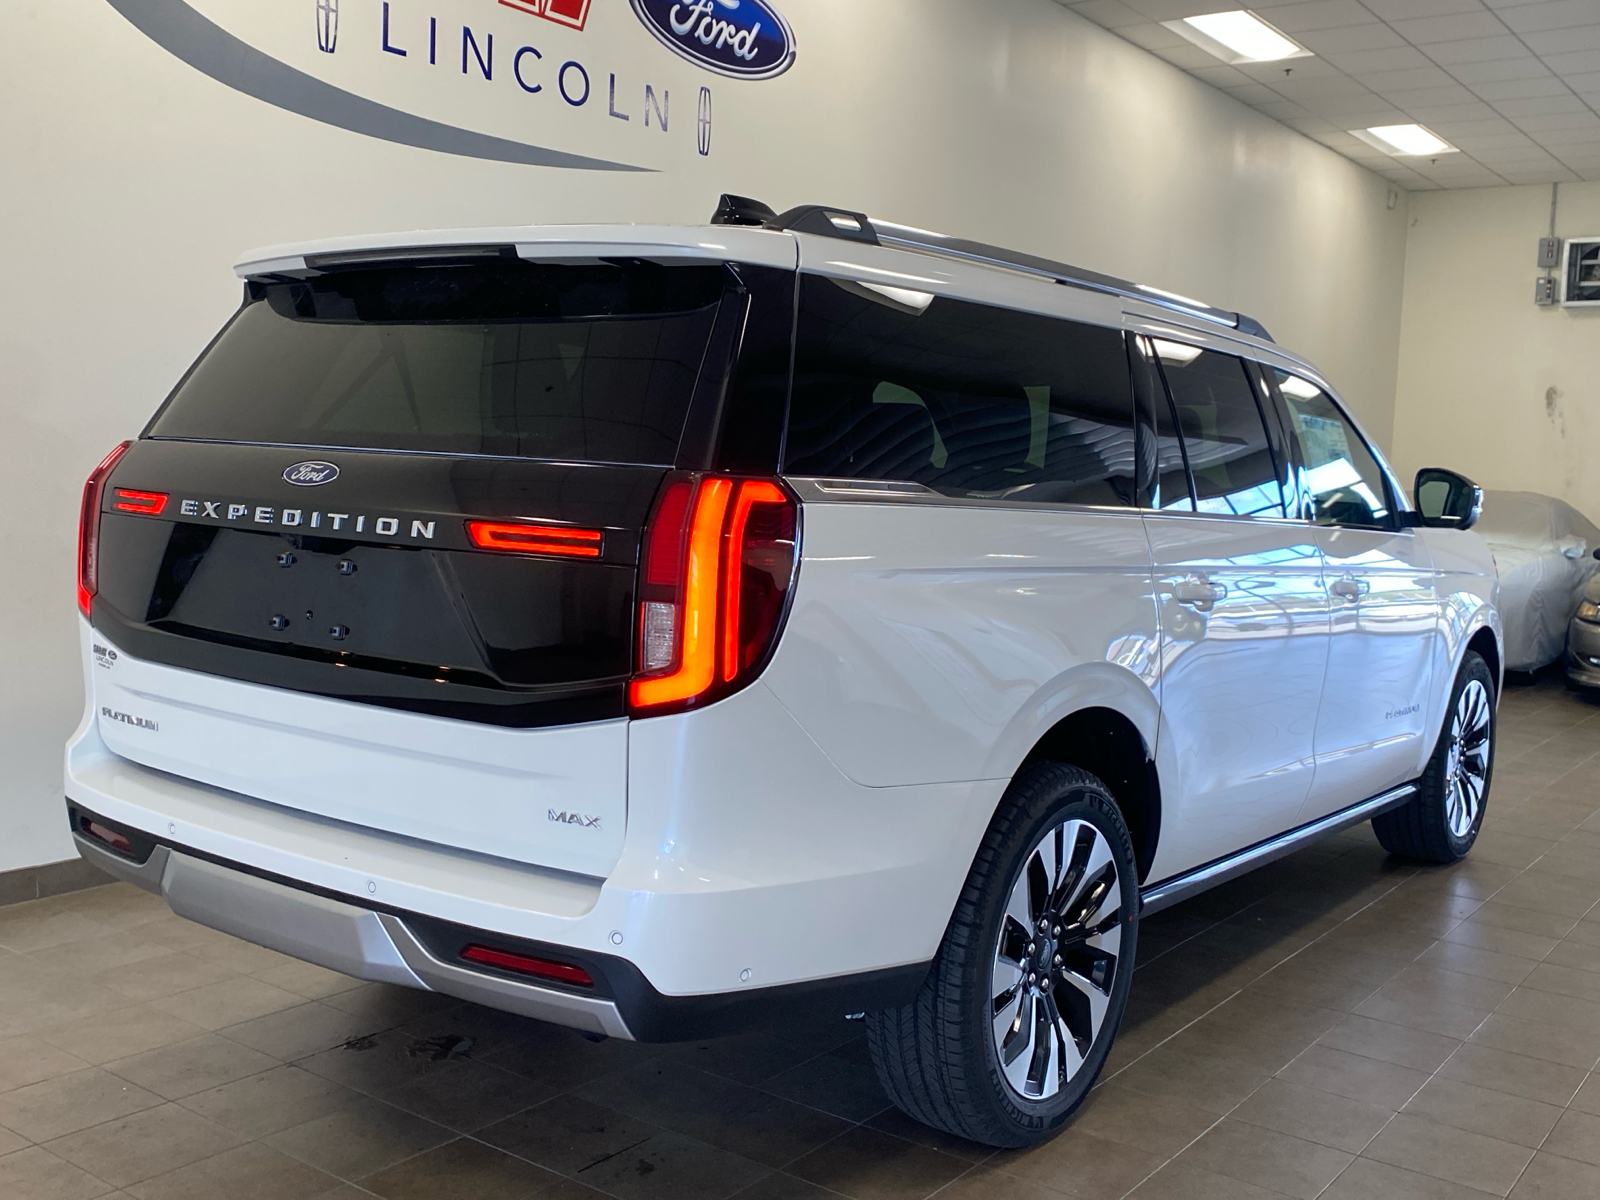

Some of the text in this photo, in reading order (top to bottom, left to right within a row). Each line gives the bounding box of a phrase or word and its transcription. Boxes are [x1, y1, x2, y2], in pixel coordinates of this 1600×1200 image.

[669, 0, 761, 60] Ford
[382, 1, 669, 132] LINCOLN
[291, 463, 330, 482] Ford
[180, 499, 436, 539] EXPEDITION
[102, 706, 159, 731] PLATINUM
[547, 808, 602, 830] MAX
